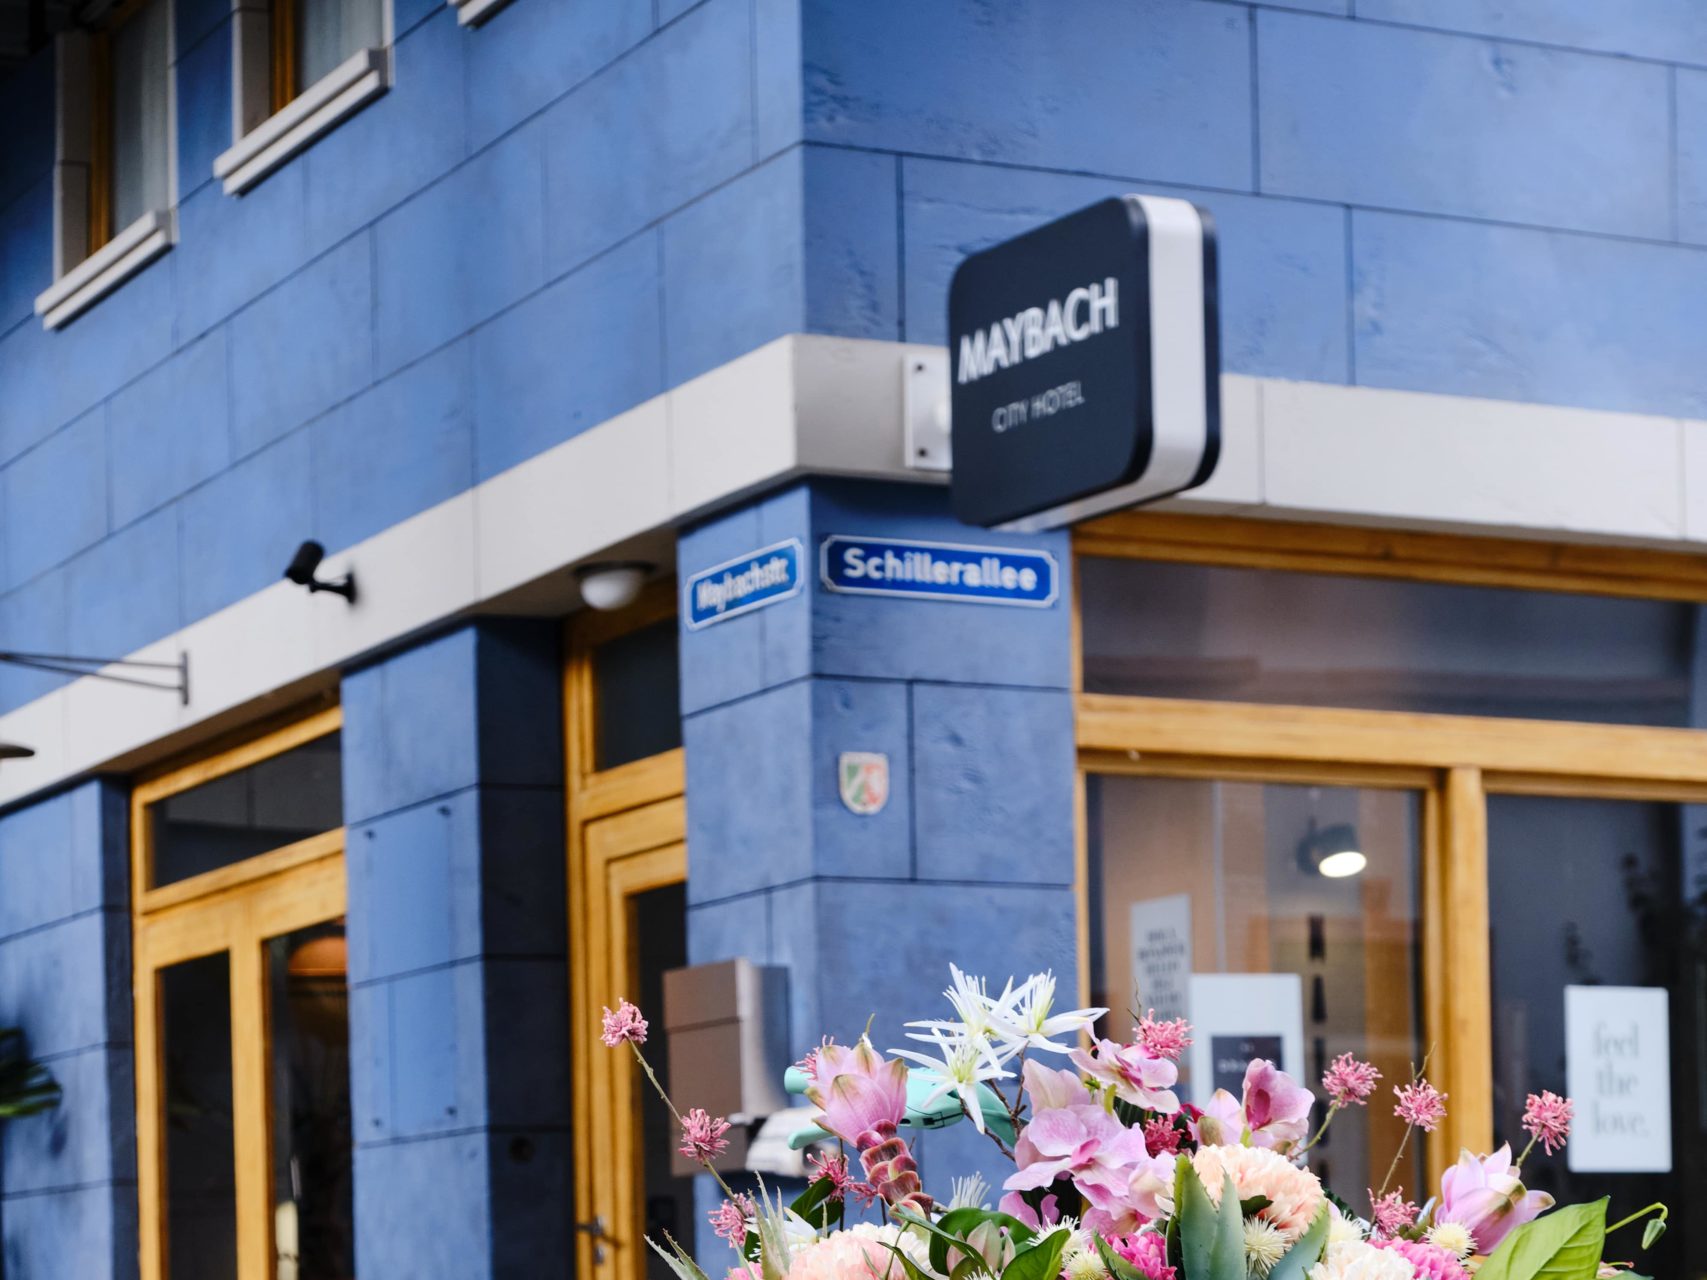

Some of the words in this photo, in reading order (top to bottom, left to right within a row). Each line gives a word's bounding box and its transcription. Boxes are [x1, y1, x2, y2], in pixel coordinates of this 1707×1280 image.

[958, 276, 1119, 384] MAYBACH
[992, 399, 1029, 433] CITY
[1031, 380, 1085, 419] HOTEL
[842, 546, 1038, 591] Schillerallee
[1592, 1019, 1640, 1058] feel
[1594, 1058, 1639, 1097] the
